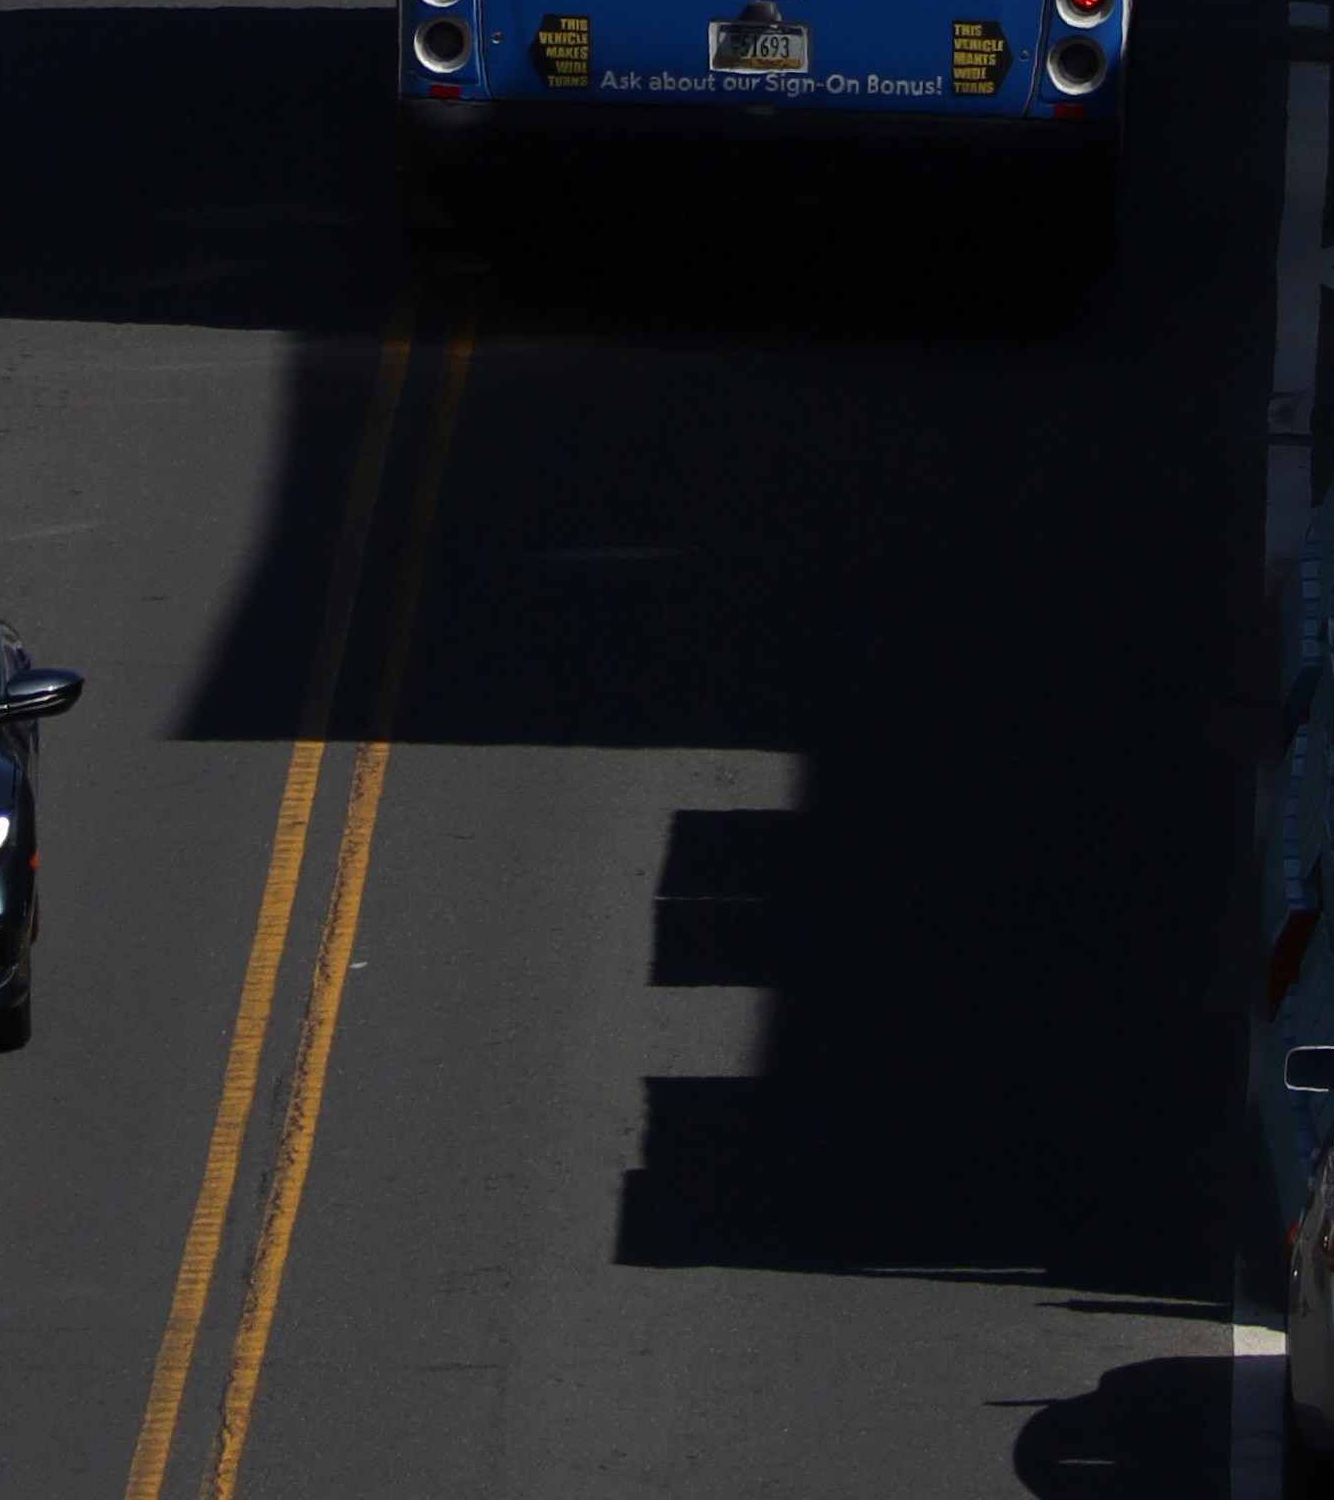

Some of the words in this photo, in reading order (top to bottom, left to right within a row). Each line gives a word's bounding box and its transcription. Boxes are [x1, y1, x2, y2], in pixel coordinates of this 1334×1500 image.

[560, 18, 588, 31] THIS
[954, 23, 983, 36] THIS
[539, 31, 588, 45] VEHICLE
[954, 38, 1004, 52] VEHICLE
[546, 47, 588, 59] MAKES
[954, 52, 996, 66] MAKES
[556, 61, 588, 74] WIDE
[954, 67, 987, 80] WIDE
[547, 75, 588, 88] TURNS
[600, 71, 642, 90] Ask
[649, 71, 716, 92] about
[722, 75, 760, 91] our
[764, 73, 860, 98] Sign-On
[867, 74, 943, 96] Bonus!
[954, 81, 994, 94] TURNS
